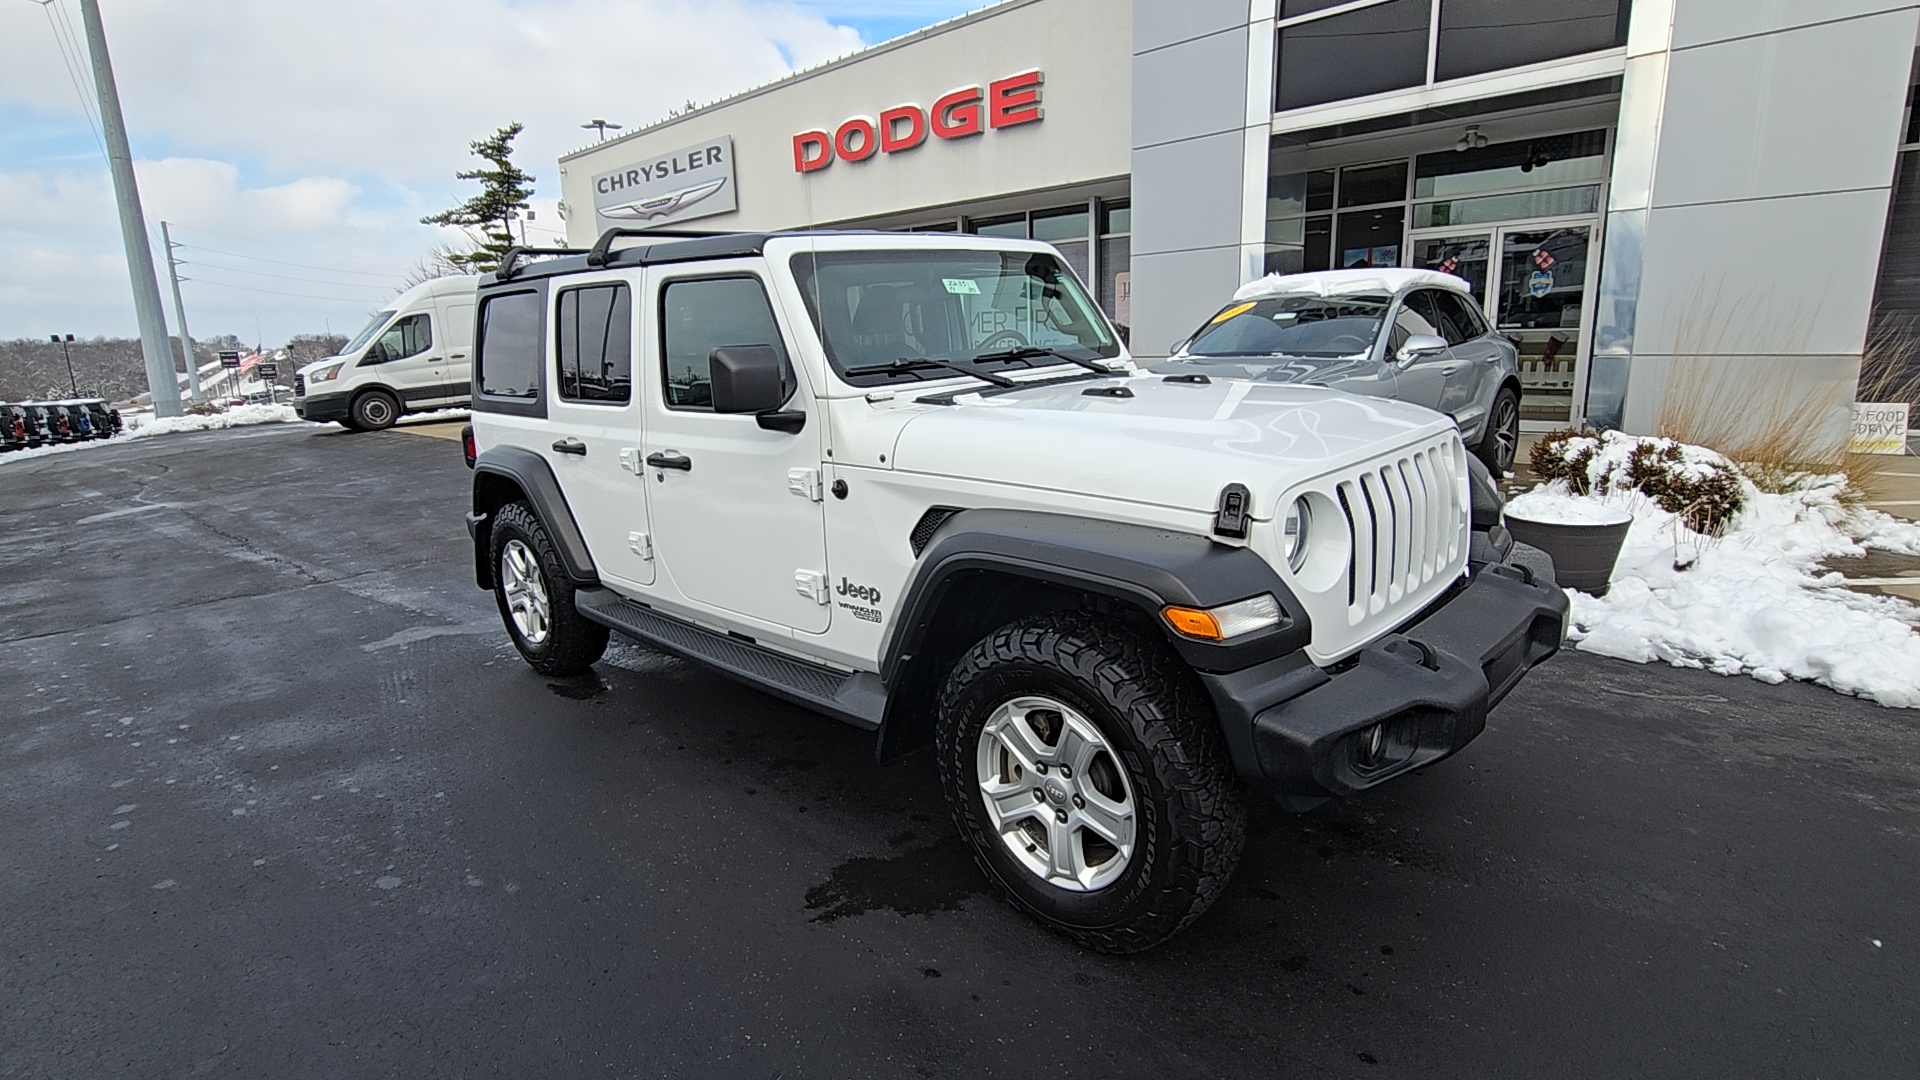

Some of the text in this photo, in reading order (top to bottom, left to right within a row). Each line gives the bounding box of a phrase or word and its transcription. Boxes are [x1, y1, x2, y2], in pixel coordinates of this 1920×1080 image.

[792, 68, 1045, 173] DODGE
[597, 145, 722, 194] CHRYSLER
[1858, 423, 1905, 436] DRIVE
[1866, 410, 1905, 422] FOOD
[836, 577, 881, 606] Jeep
